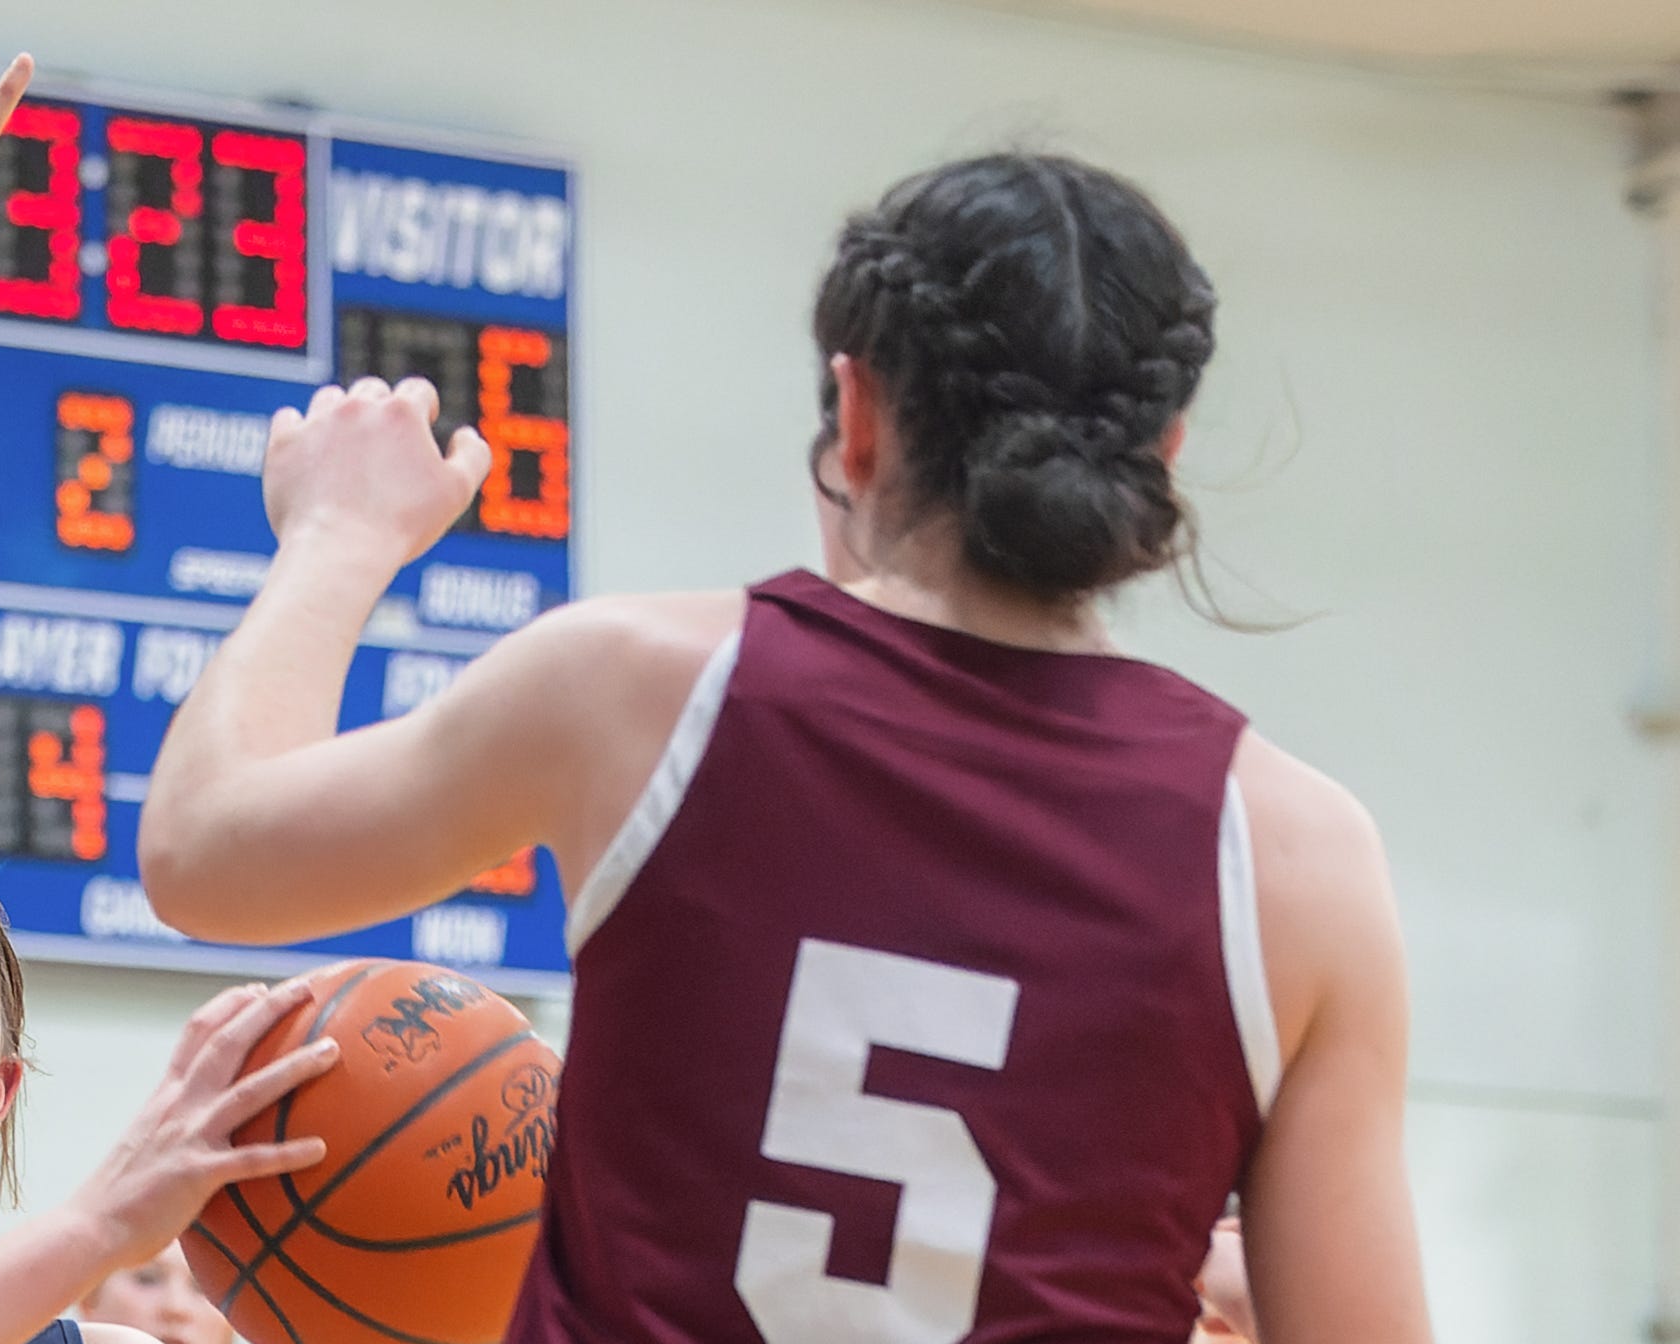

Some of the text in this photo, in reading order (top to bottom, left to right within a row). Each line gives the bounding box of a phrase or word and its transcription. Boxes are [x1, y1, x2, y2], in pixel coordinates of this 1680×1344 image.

[328, 167, 568, 300] VISITOR
[56, 391, 135, 550] 2
[477, 324, 570, 540] 6
[29, 704, 107, 861] 4
